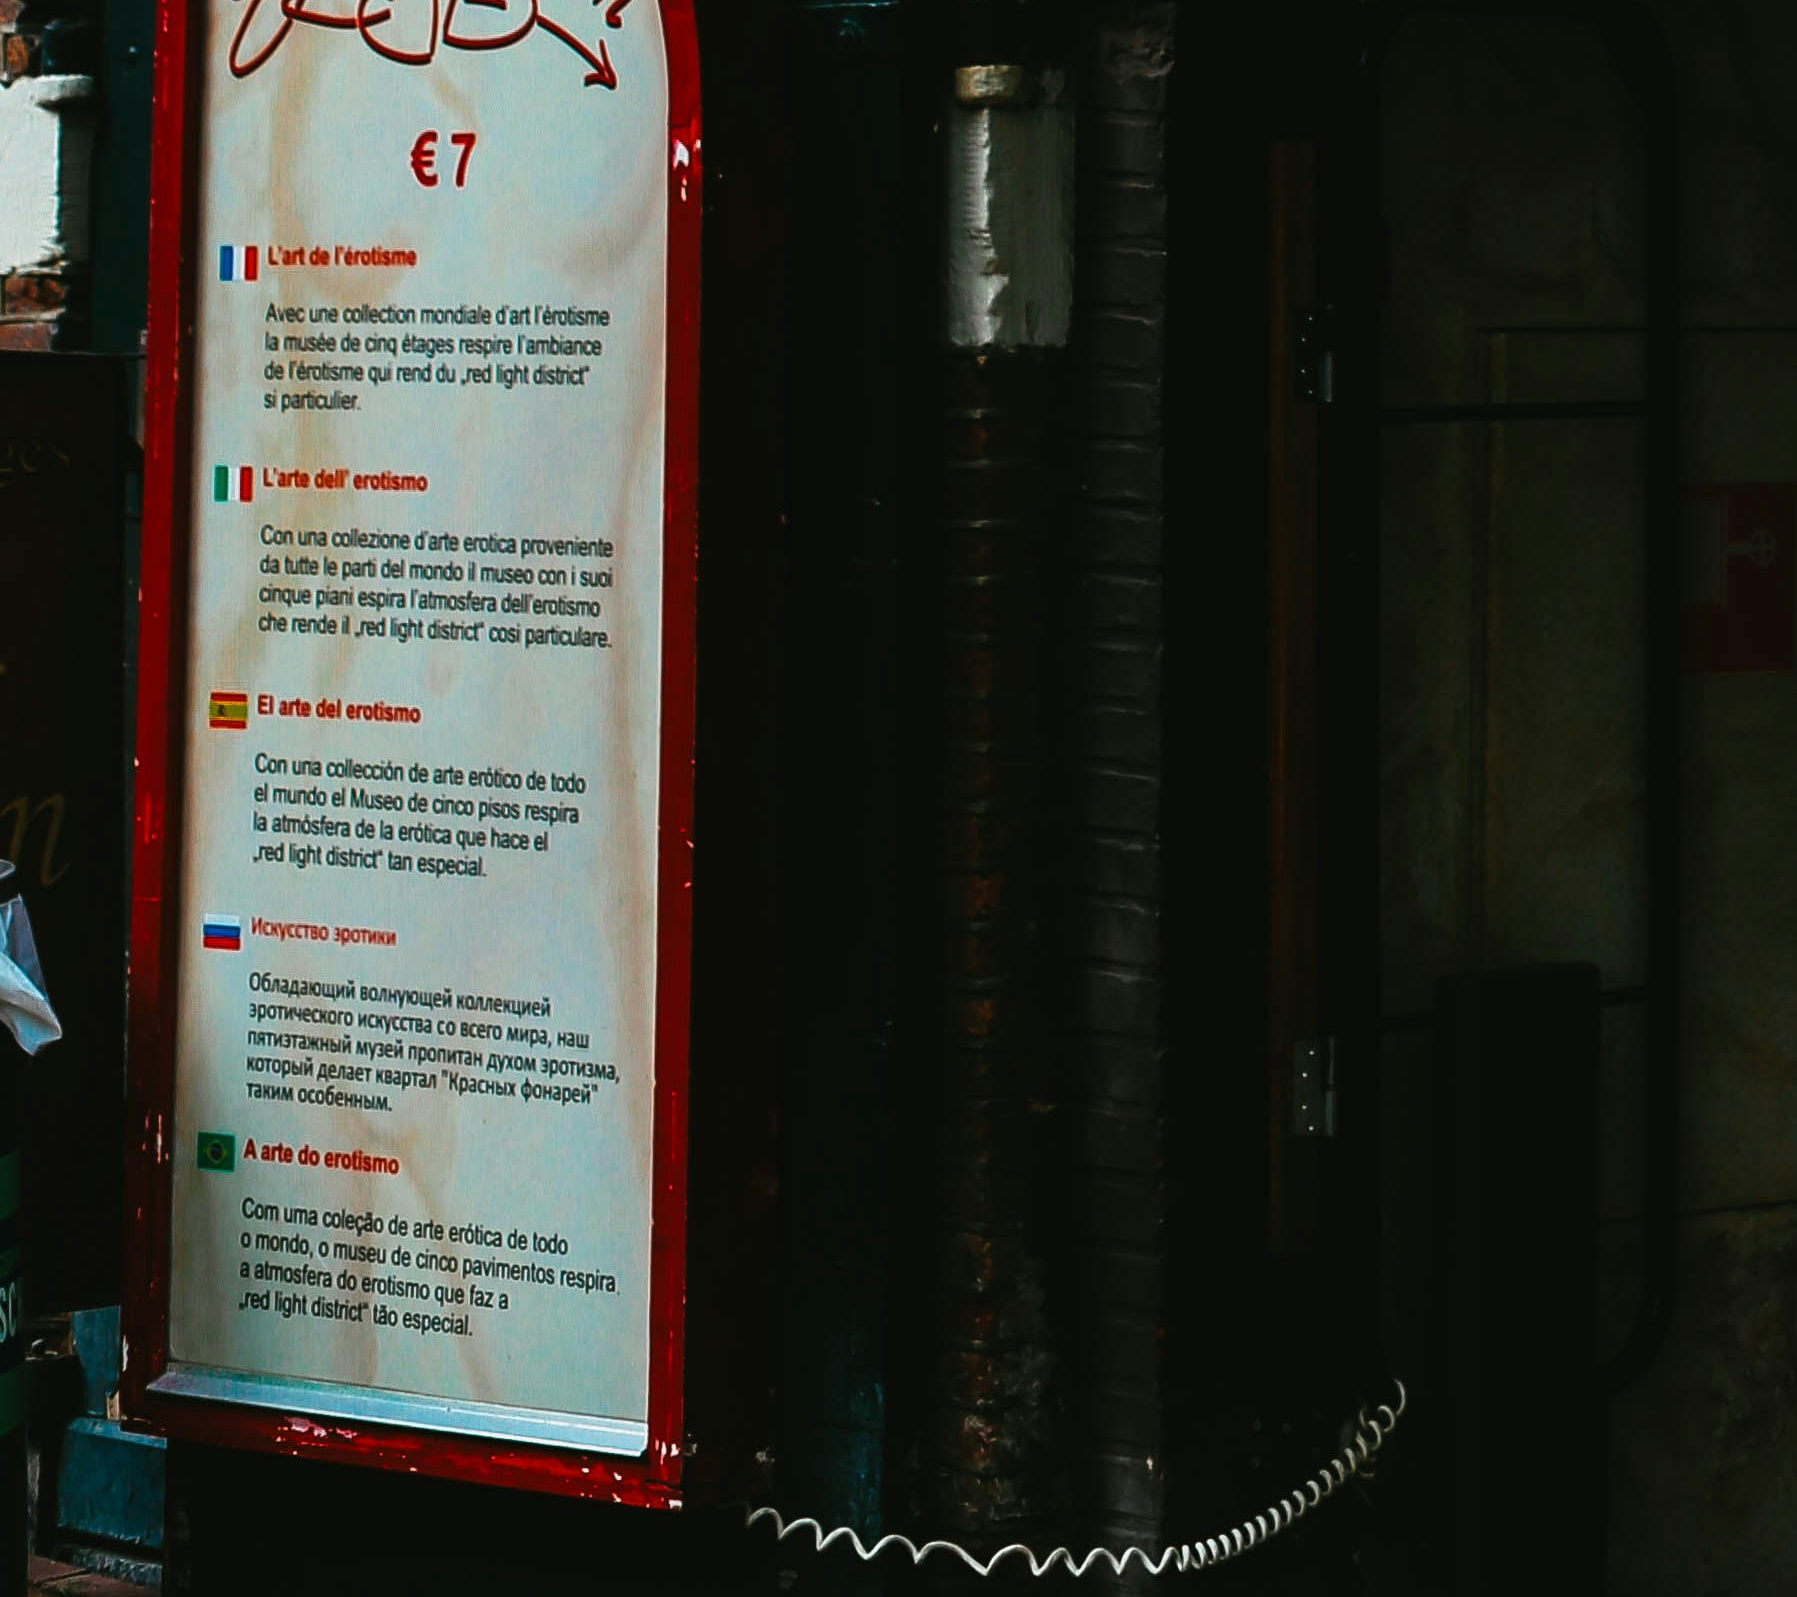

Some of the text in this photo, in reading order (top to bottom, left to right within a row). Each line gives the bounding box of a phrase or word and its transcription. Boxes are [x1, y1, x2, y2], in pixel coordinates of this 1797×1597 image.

[409, 131, 477, 188] € 7
[308, 245, 331, 268] de
[352, 470, 429, 493] erotismo
[256, 693, 422, 725] El arte del erotismo
[242, 1137, 400, 1176] A arte do erotismo
[241, 1195, 570, 1257] Com uma coleção de arte erótica de todo
[238, 1259, 510, 1311] a atmosfera do erotismo que faz a
